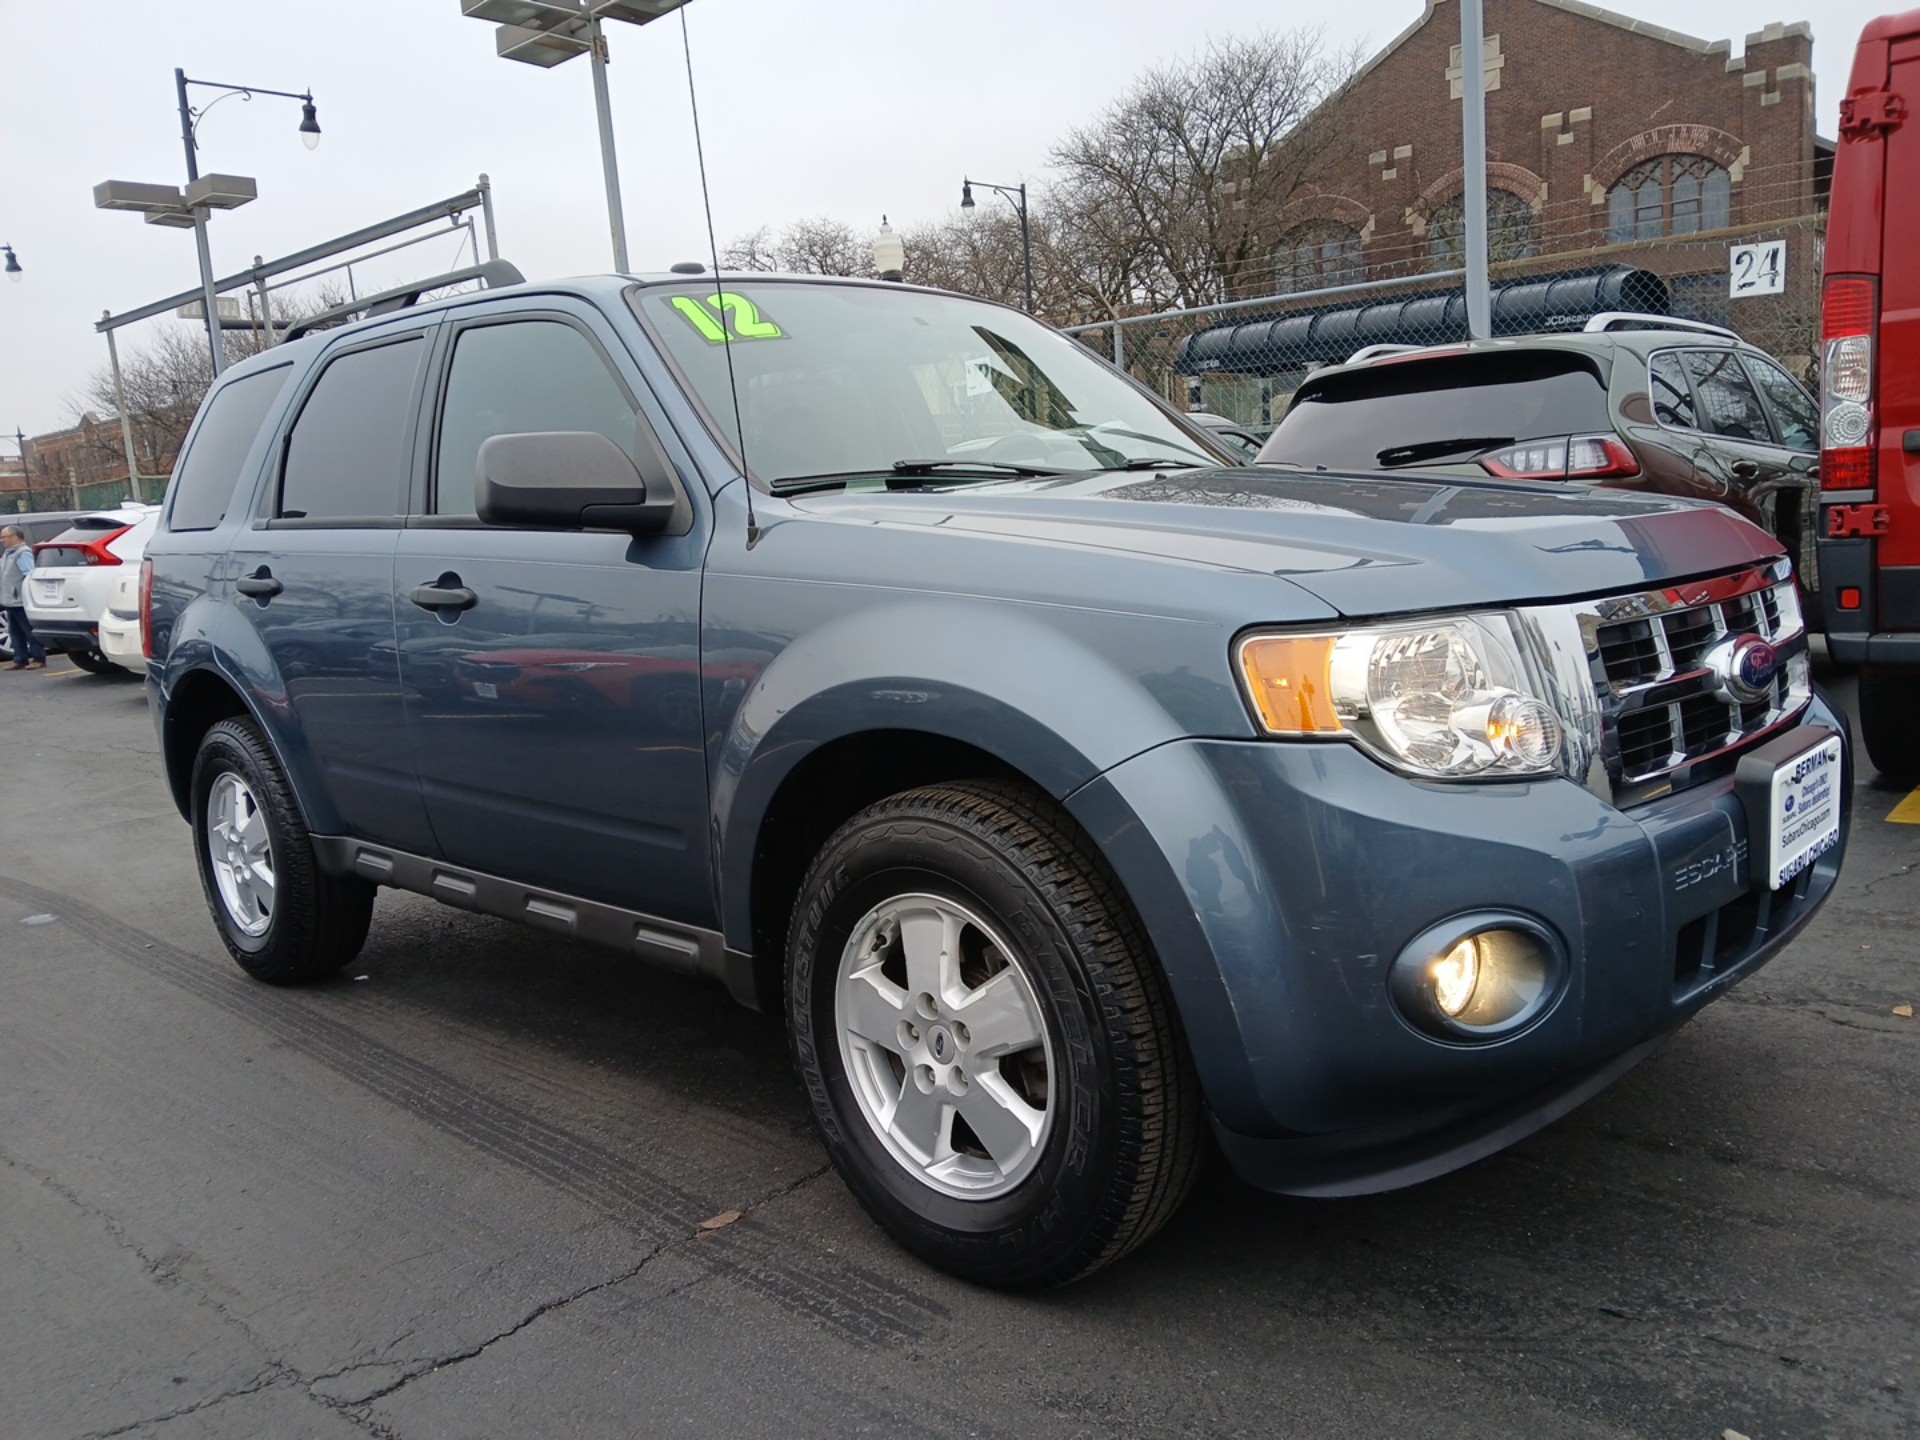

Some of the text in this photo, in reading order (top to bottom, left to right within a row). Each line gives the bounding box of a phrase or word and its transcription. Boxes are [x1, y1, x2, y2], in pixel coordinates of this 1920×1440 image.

[1735, 248, 1779, 291] 24
[672, 292, 782, 341] 12
[1795, 748, 1828, 778] BERMAN
[1782, 808, 1830, 848] SubaruChicago.com
[1675, 838, 1748, 892] ESCAPE
[1779, 829, 1838, 886] SUBARU CHICAGO
